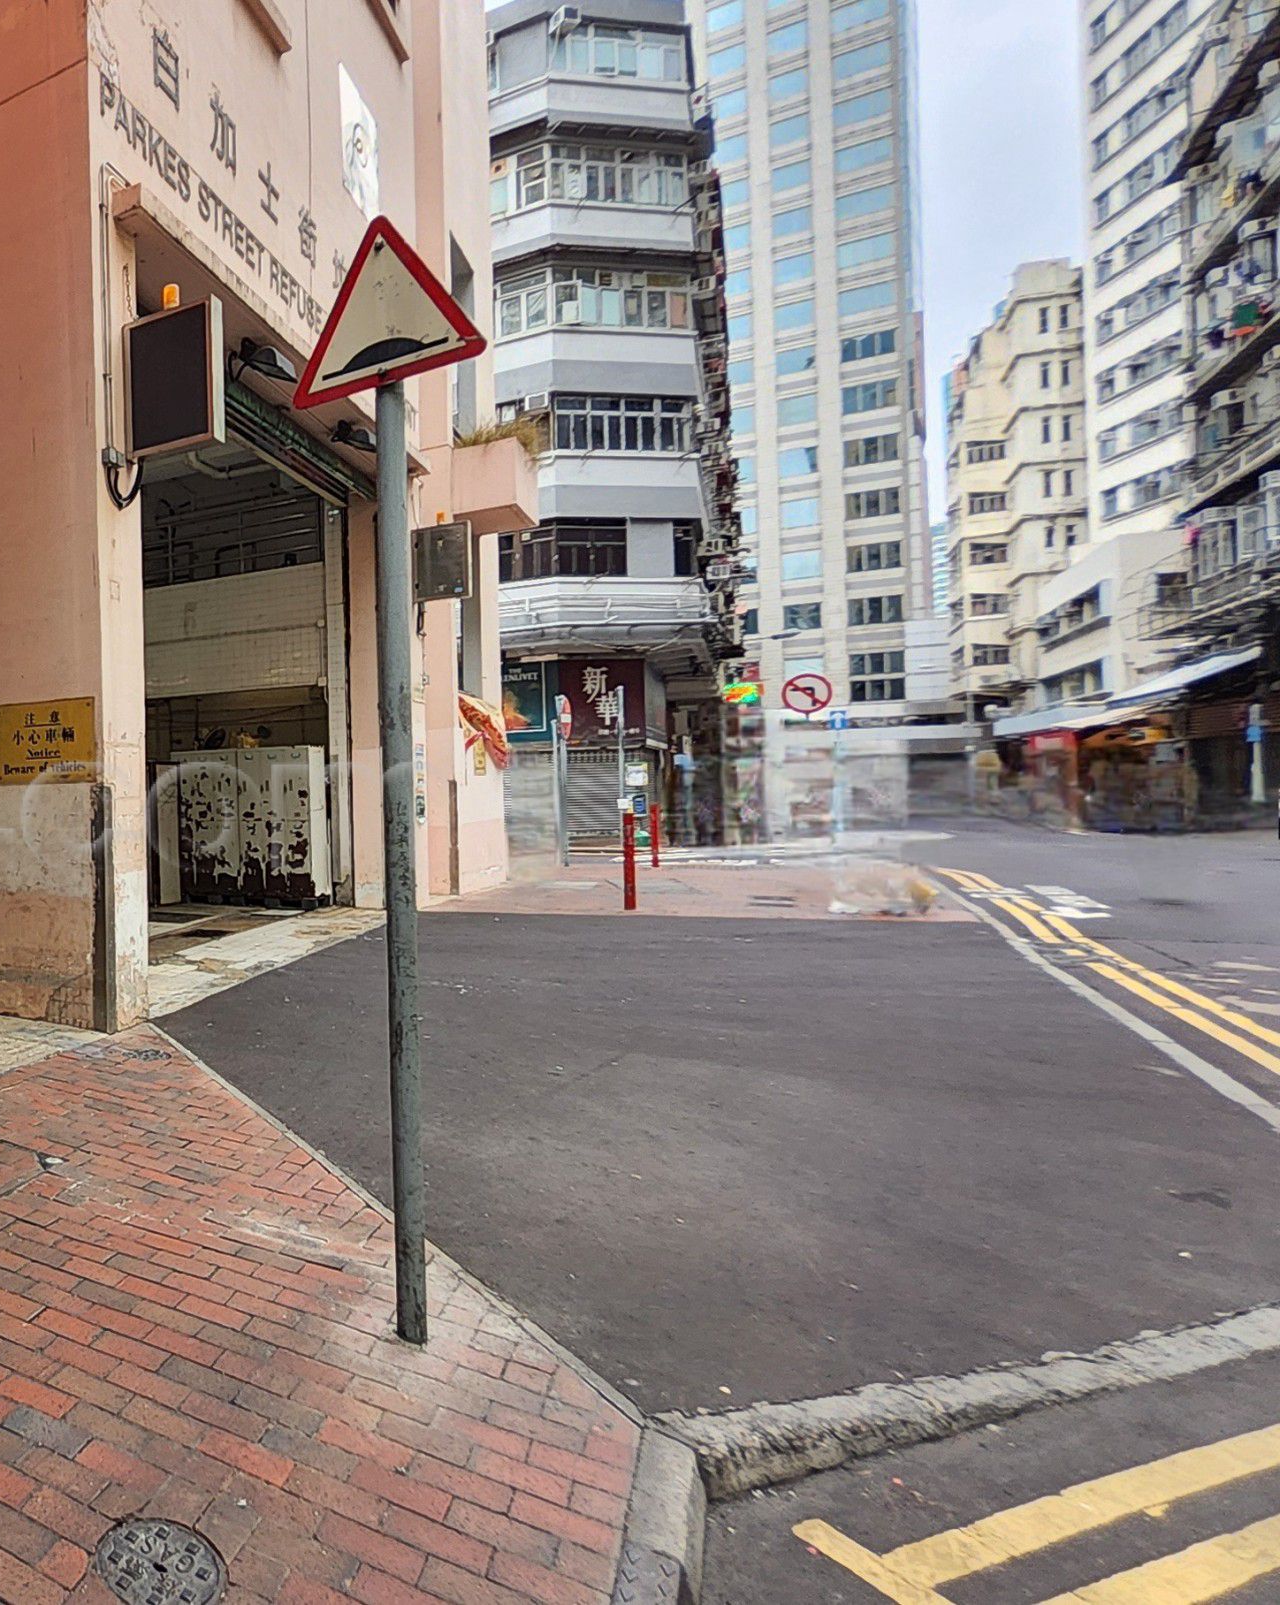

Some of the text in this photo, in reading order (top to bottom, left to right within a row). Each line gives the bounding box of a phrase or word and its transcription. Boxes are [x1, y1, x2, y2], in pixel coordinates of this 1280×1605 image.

[99, 71, 323, 335] PARKES STREET REFUSE
[582, 666, 619, 726] 新華
[24, 710, 60, 726] 注意
[27, 748, 61, 757] Notice
[3, 763, 36, 776] Beware
[38, 761, 49, 773] of
